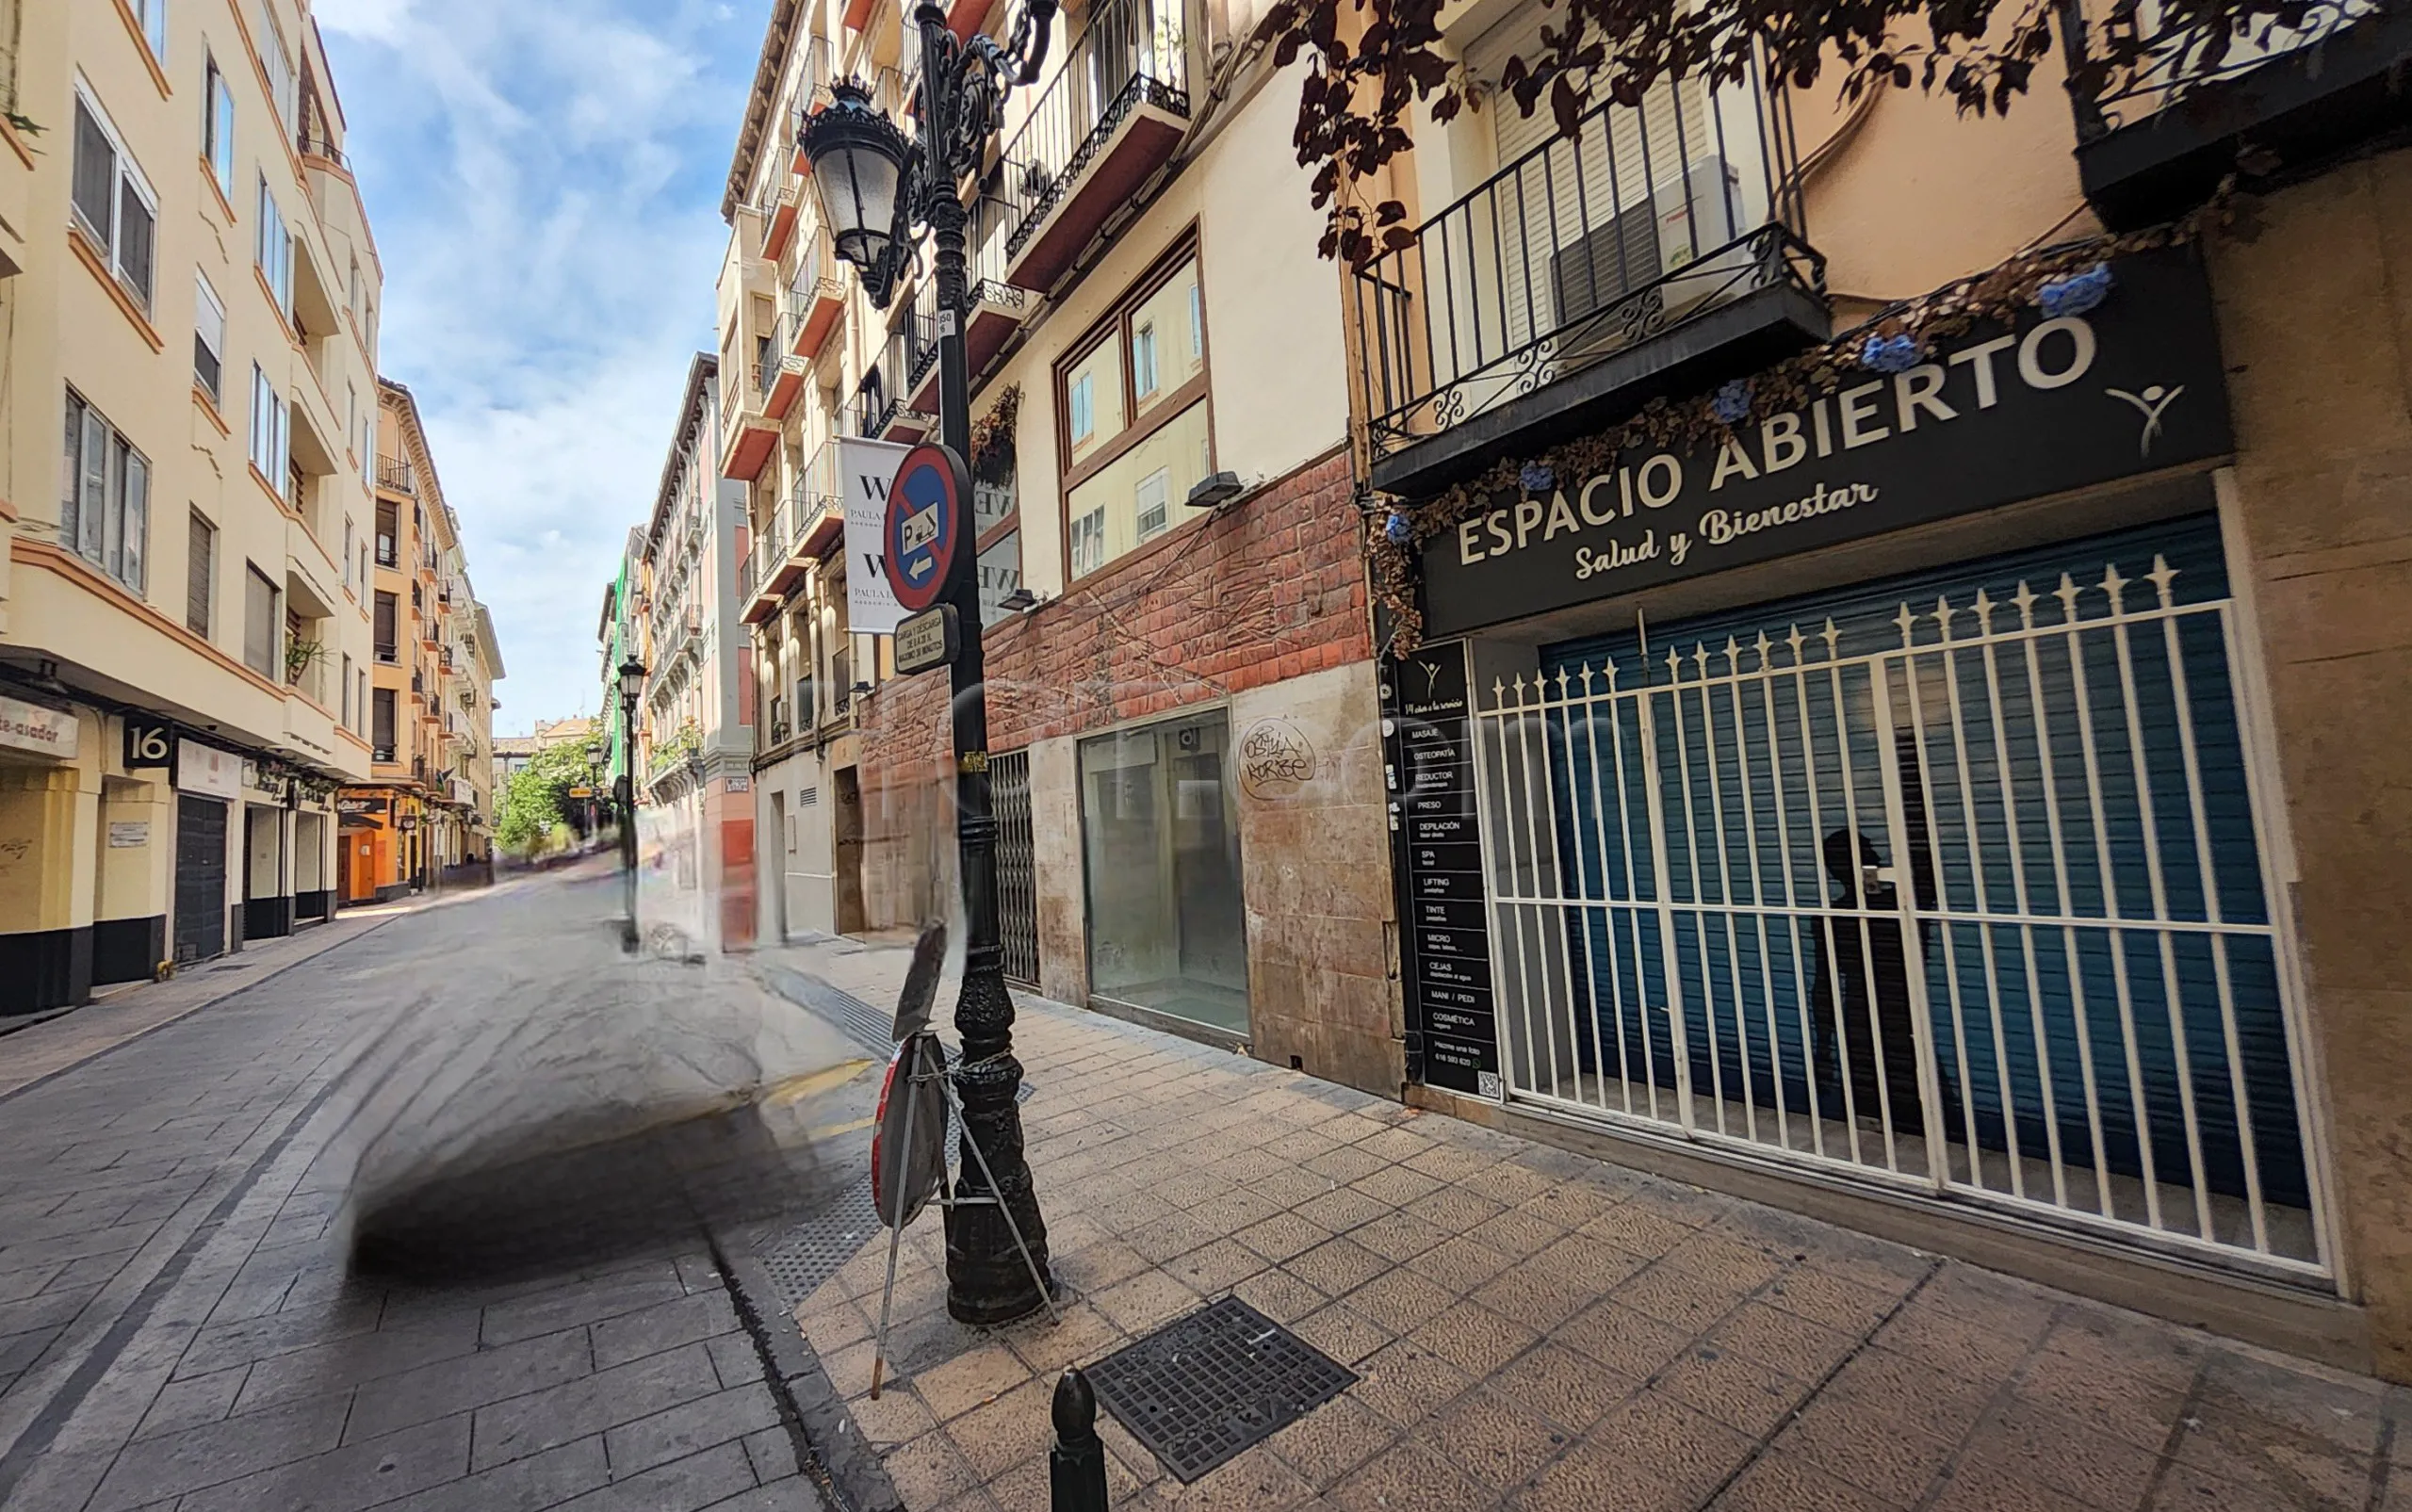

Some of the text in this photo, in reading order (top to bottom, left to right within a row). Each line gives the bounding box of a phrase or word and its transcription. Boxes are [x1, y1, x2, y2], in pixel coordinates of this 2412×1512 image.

[1459, 316, 2096, 565] ESPACIO ABIERTO
[1575, 482, 1880, 580] Salud y Bienestar
[1411, 727, 1439, 740] MASAJE
[129, 726, 168, 759] 16
[1413, 748, 1456, 761] OSTEOPATÍA
[1415, 771, 1453, 783] REDUCTOR
[1417, 801, 1442, 810] PRESO
[1419, 821, 1459, 831] DEPILACIÓN
[1421, 850, 1435, 859] SPA
[1423, 878, 1450, 887] LIFTING
[1425, 905, 1445, 915] TINTE
[1427, 935, 1451, 944] MICRO
[1429, 962, 1452, 971] CEJAS
[1431, 990, 1449, 1000] MANI
[1458, 993, 1475, 1004] PEDI
[1432, 1012, 1475, 1027] COSMÉTICA
